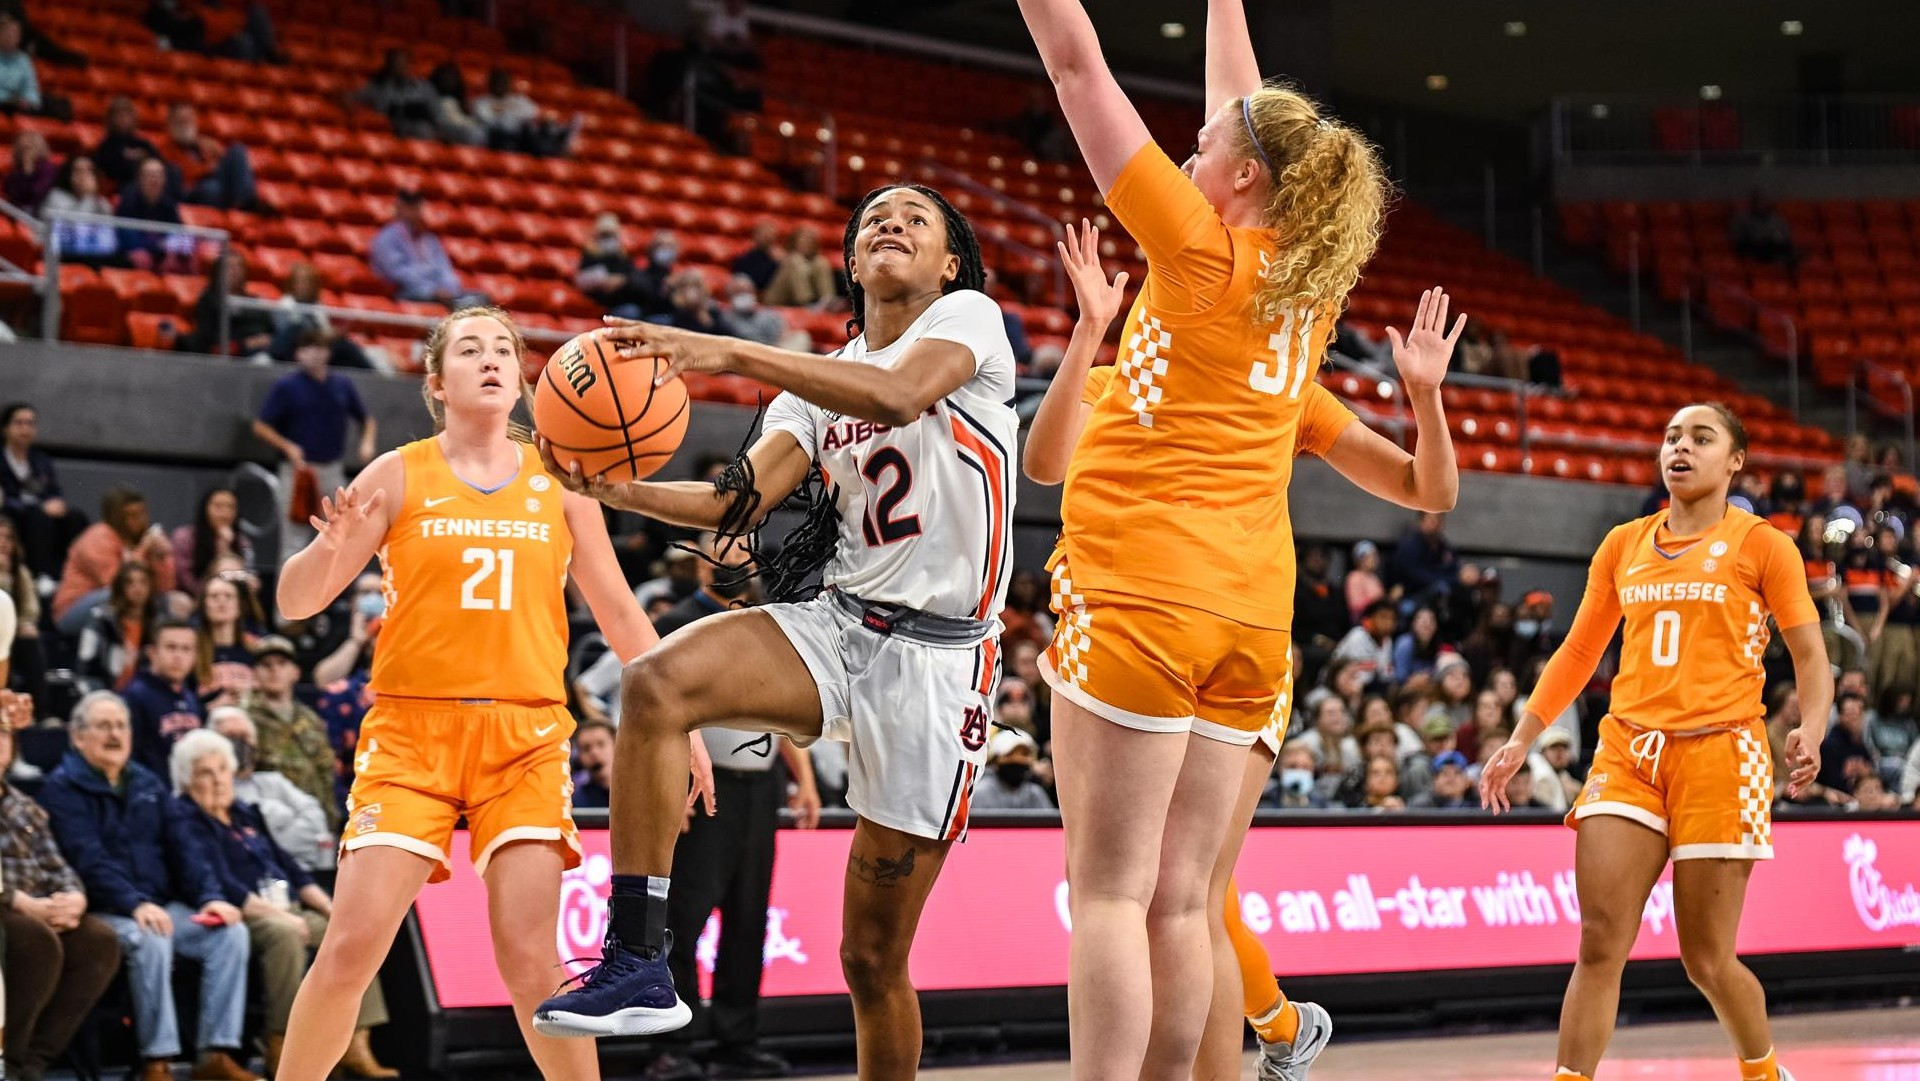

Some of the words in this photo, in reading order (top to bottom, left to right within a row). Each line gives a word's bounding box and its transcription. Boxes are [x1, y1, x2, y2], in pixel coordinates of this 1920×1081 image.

[1249, 298, 1314, 399] 31
[419, 518, 550, 543] TENNESSEE
[461, 547, 514, 611] 21
[1620, 582, 1728, 605] TENNESSEE
[1651, 610, 1681, 667] 0
[1276, 889, 1331, 933] an
[1333, 873, 1467, 931] all-star
[1471, 869, 1558, 926] with
